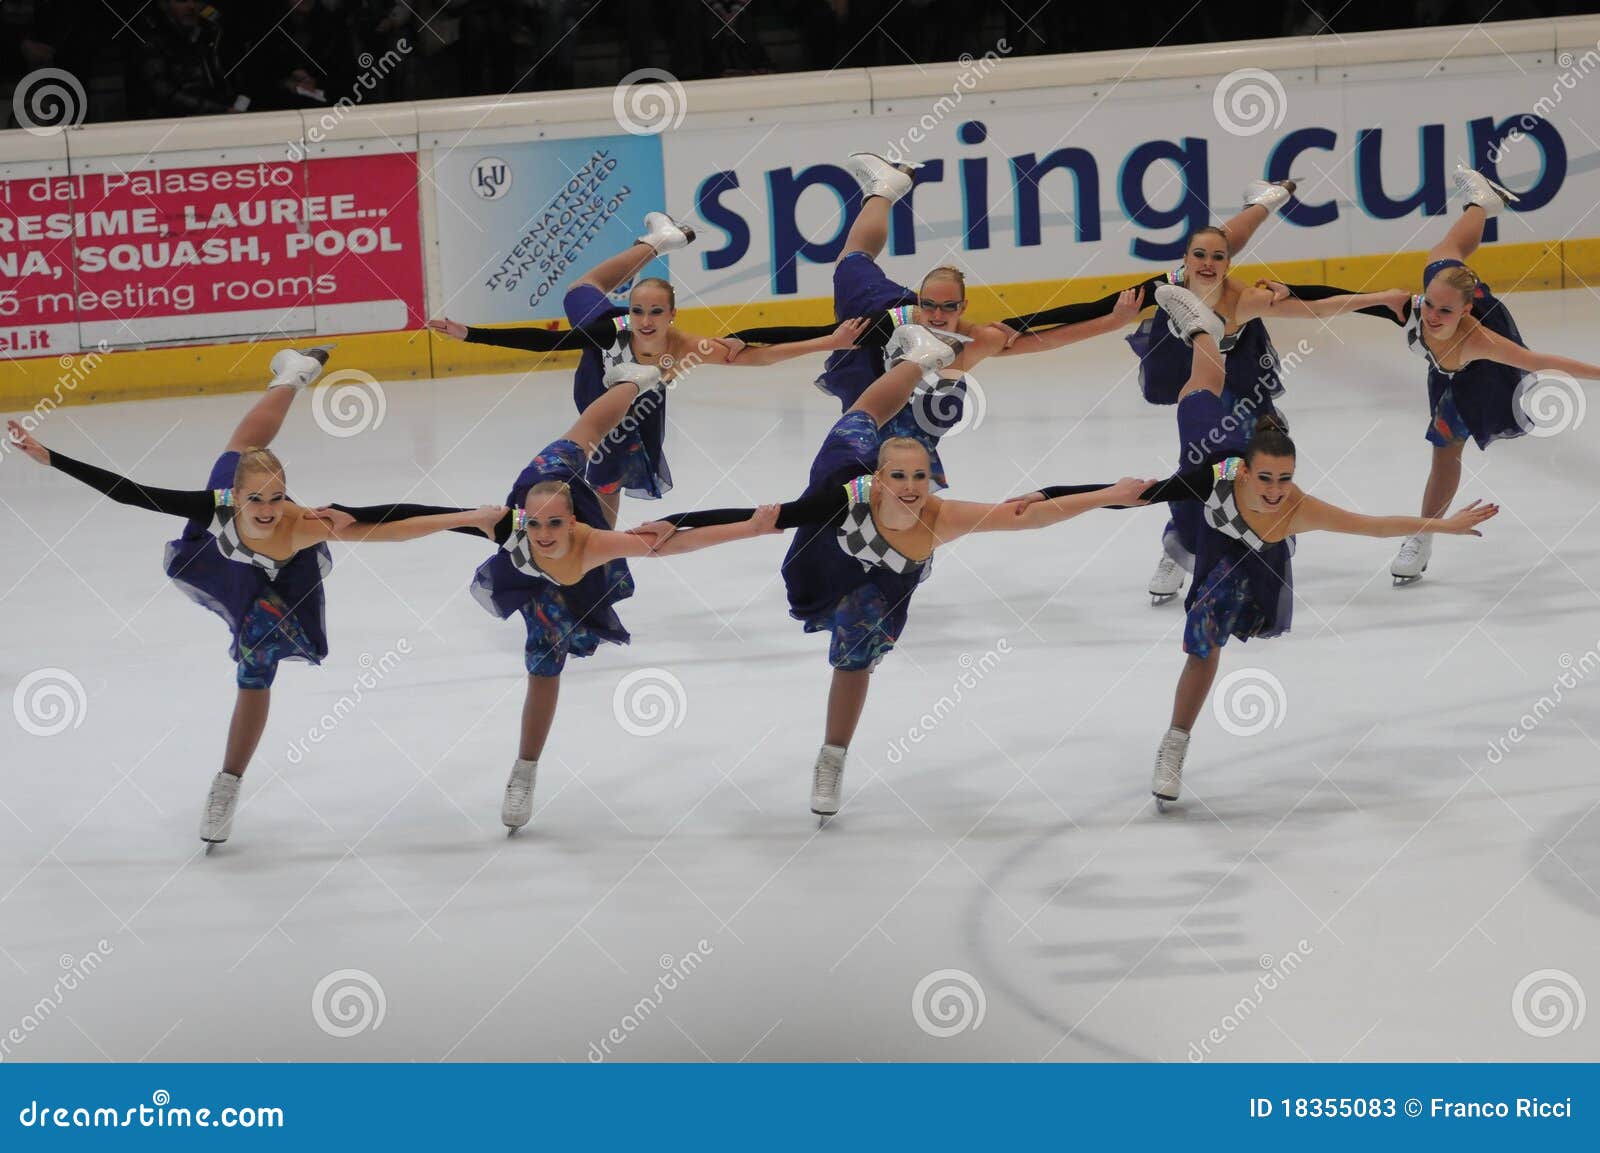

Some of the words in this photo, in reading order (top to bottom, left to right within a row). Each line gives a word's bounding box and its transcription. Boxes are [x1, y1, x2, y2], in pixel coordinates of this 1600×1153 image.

[29, 172, 85, 201] dal
[103, 164, 293, 198] Palasesto
[184, 194, 388, 231] LAUREE...
[486, 150, 609, 290] INTERNATIONAL
[695, 120, 1210, 294] spring
[1264, 114, 1567, 242] cup
[79, 237, 270, 273] SQUASH,
[287, 227, 402, 258] POOL
[505, 158, 617, 292] SYNCHRONIZED
[529, 185, 631, 307] COMPETITION
[540, 196, 604, 272] SKATING
[38, 283, 194, 314] meeting
[213, 273, 337, 301] rooms
